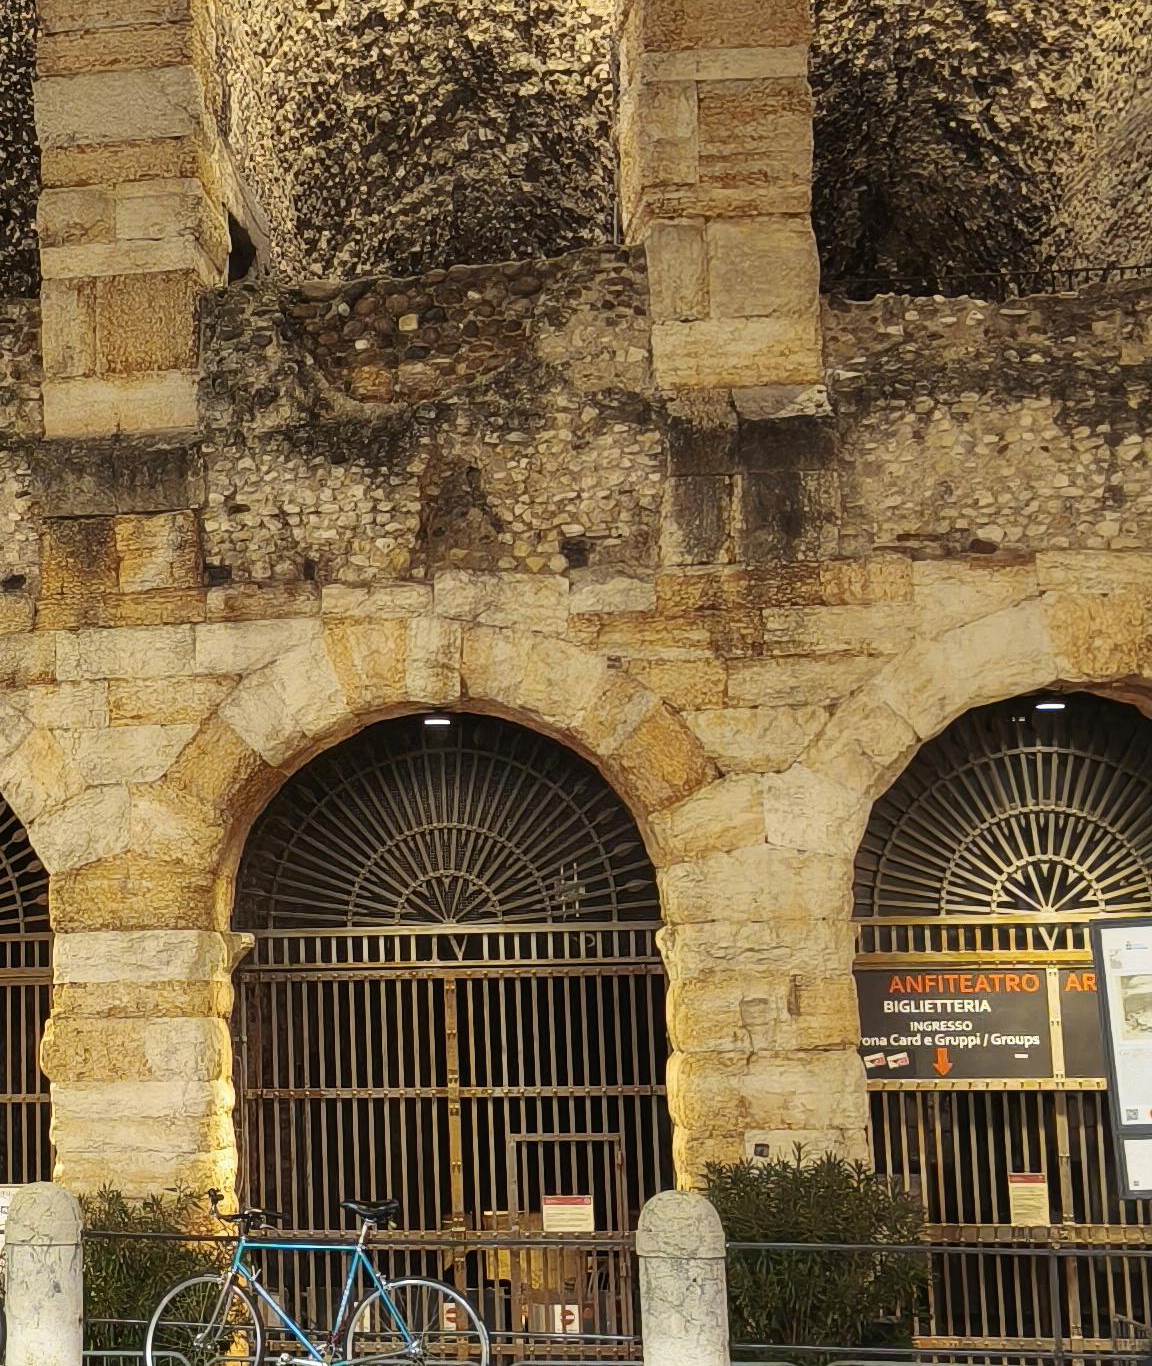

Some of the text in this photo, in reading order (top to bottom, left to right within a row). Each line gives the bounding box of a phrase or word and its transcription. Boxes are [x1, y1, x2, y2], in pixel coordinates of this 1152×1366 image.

[889, 973, 1040, 993] ANFITEATRO
[883, 999, 992, 1013] BIGLIETTERIA
[910, 1020, 973, 1032] INGRESSO
[890, 1033, 921, 1046] Card
[924, 1037, 933, 1046] e
[935, 1033, 980, 1048] Gruppi
[983, 1034, 988, 1047] /
[991, 1033, 1040, 1049] Groups
